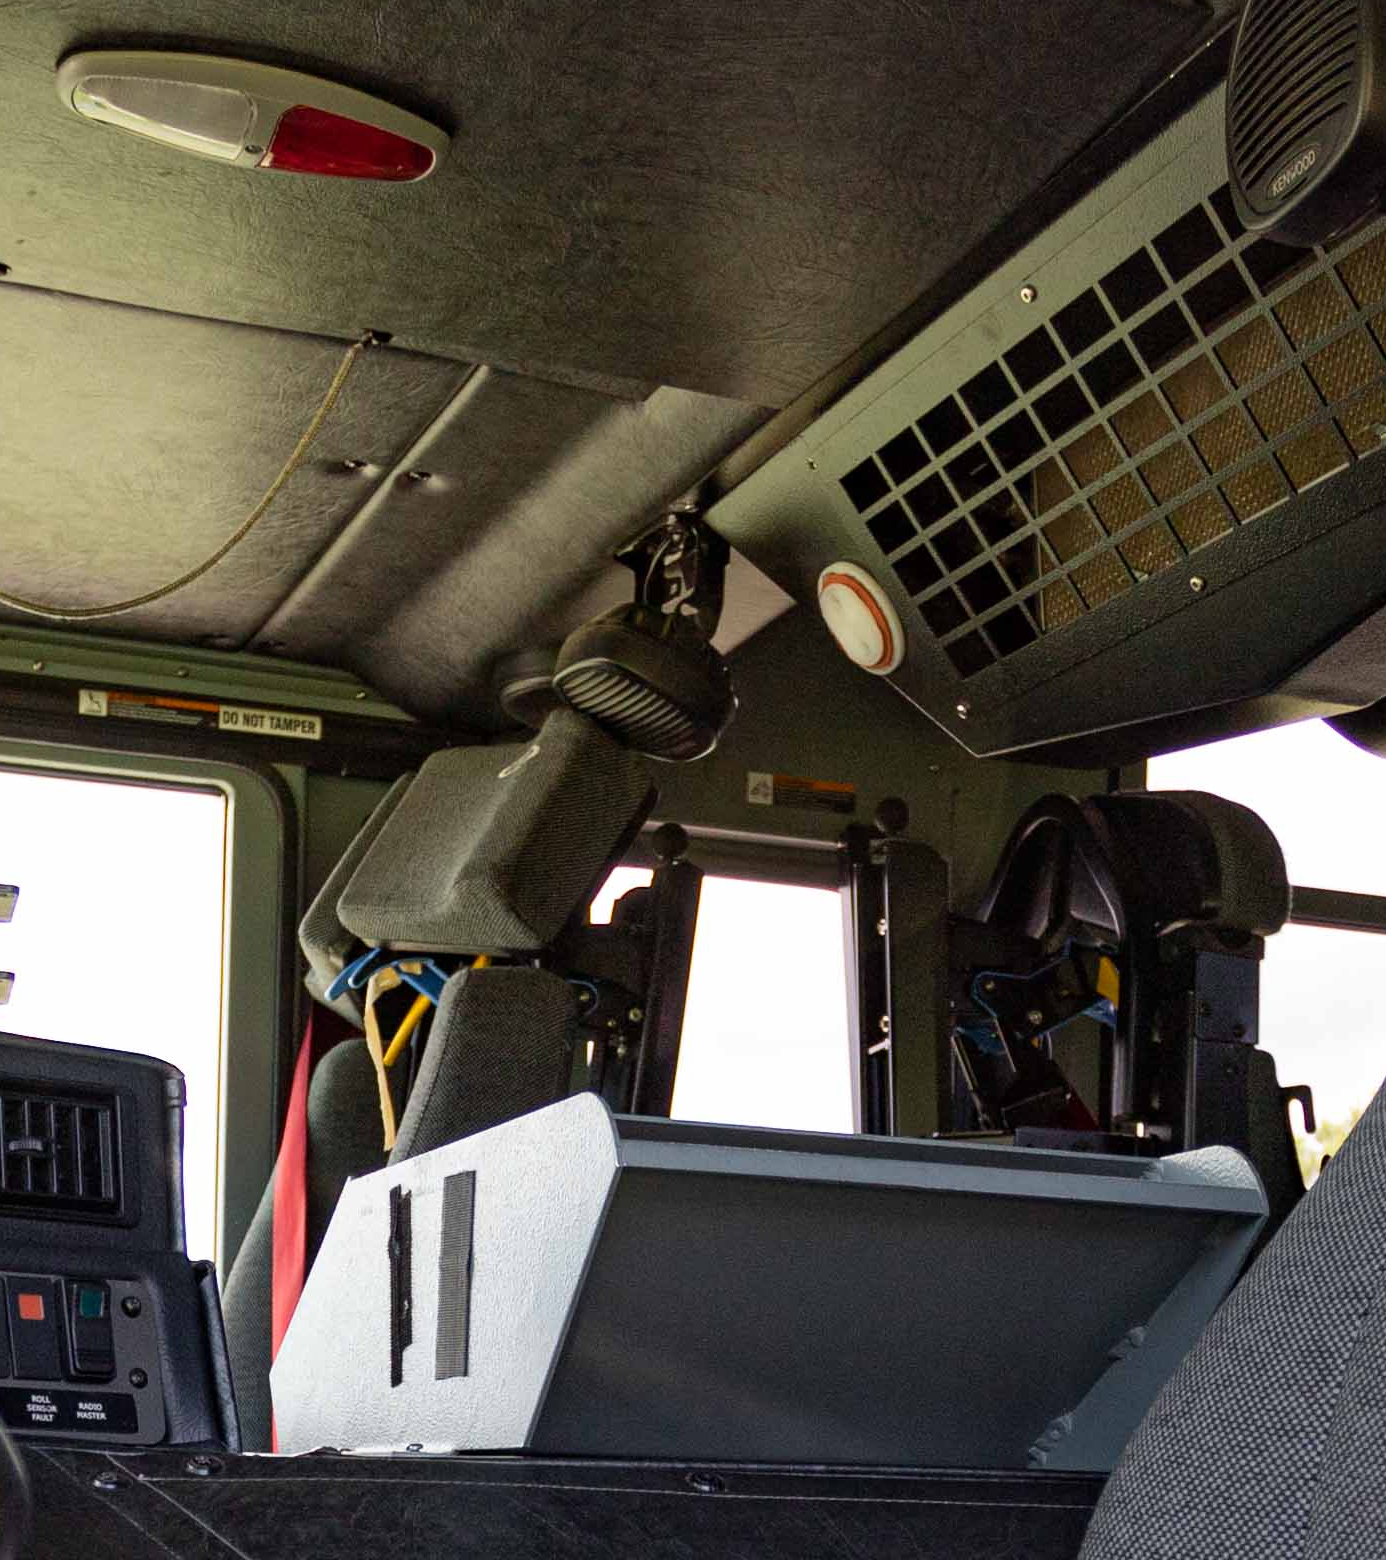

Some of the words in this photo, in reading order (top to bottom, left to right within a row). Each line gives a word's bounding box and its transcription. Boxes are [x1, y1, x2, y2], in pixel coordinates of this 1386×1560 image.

[1273, 150, 1316, 197] KENWOOD
[222, 710, 239, 724] DO
[242, 712, 264, 727] NOT
[269, 715, 317, 735] TAMPER
[31, 1395, 51, 1404] ROLL
[26, 1403, 58, 1413] SENSOR
[78, 1402, 103, 1411] RADIO
[31, 1413, 54, 1422] FAULT
[76, 1411, 107, 1421] MASTER
